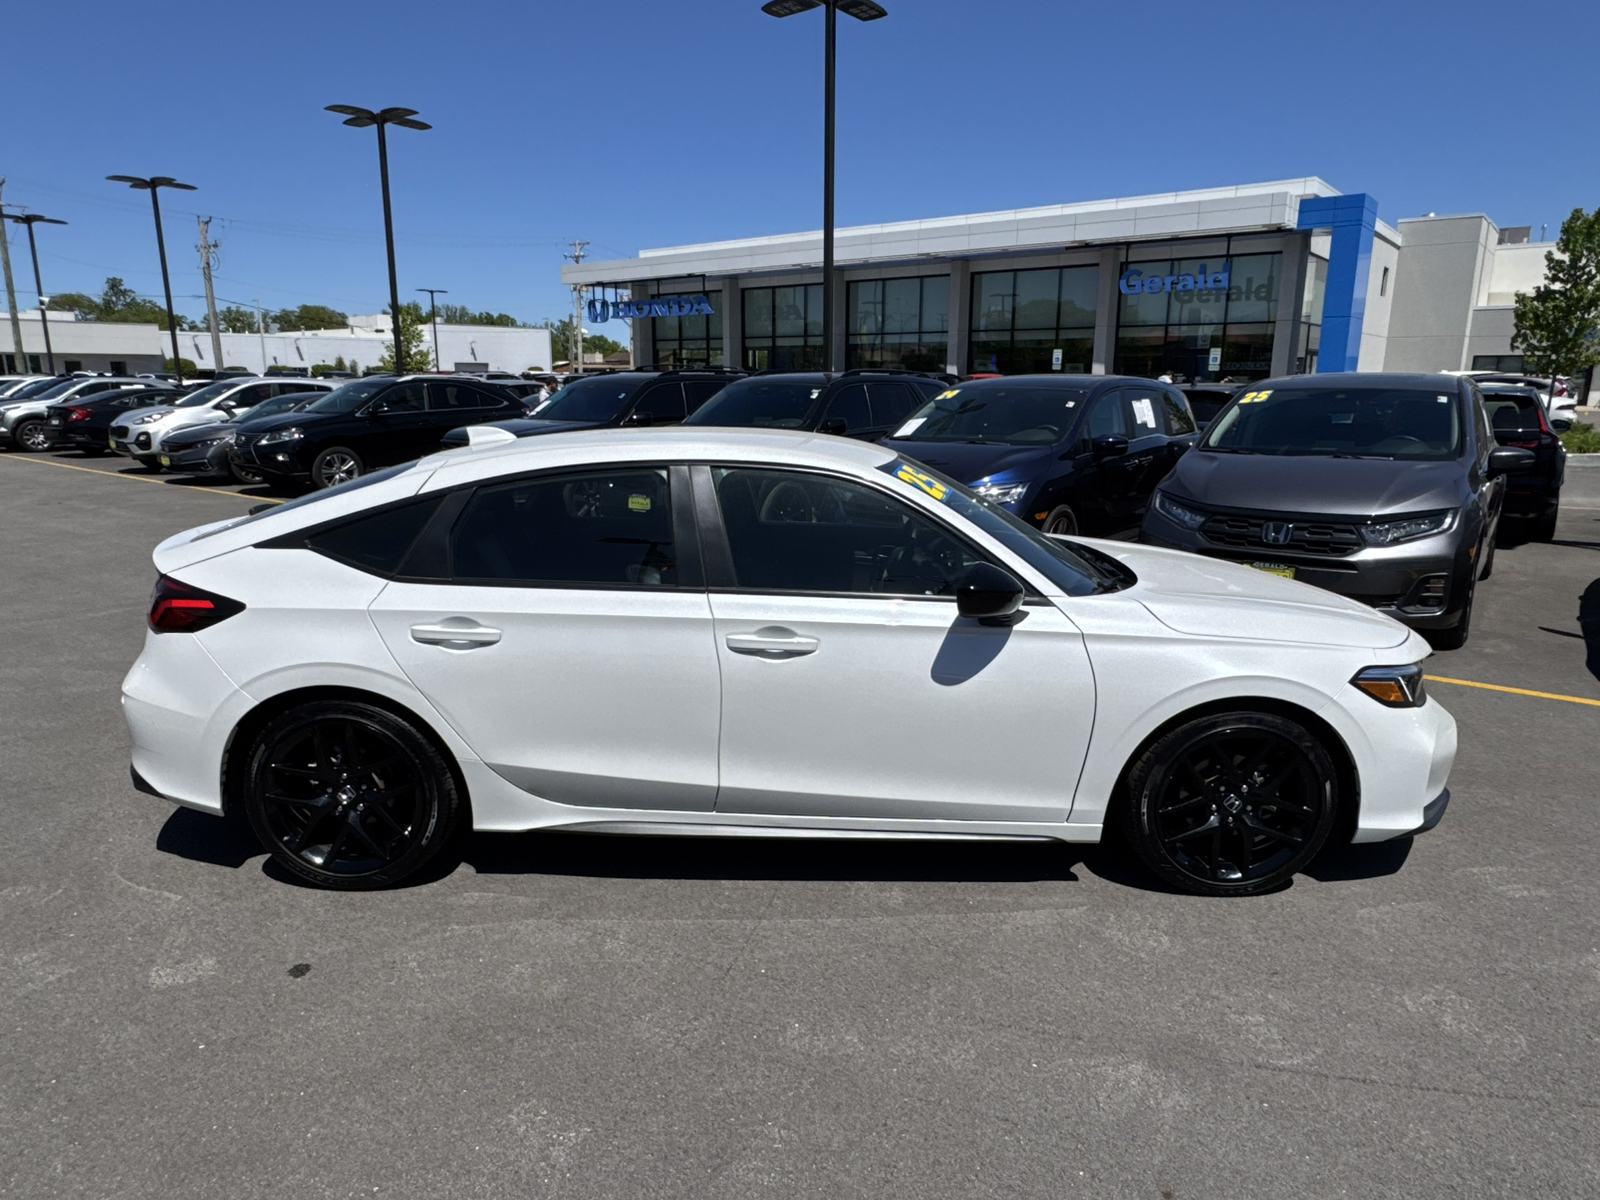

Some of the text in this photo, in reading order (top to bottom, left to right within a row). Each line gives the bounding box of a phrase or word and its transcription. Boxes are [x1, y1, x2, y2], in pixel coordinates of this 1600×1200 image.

[1120, 262, 1230, 295] Gerald
[610, 296, 714, 318] HONDA
[1239, 390, 1273, 404] 25
